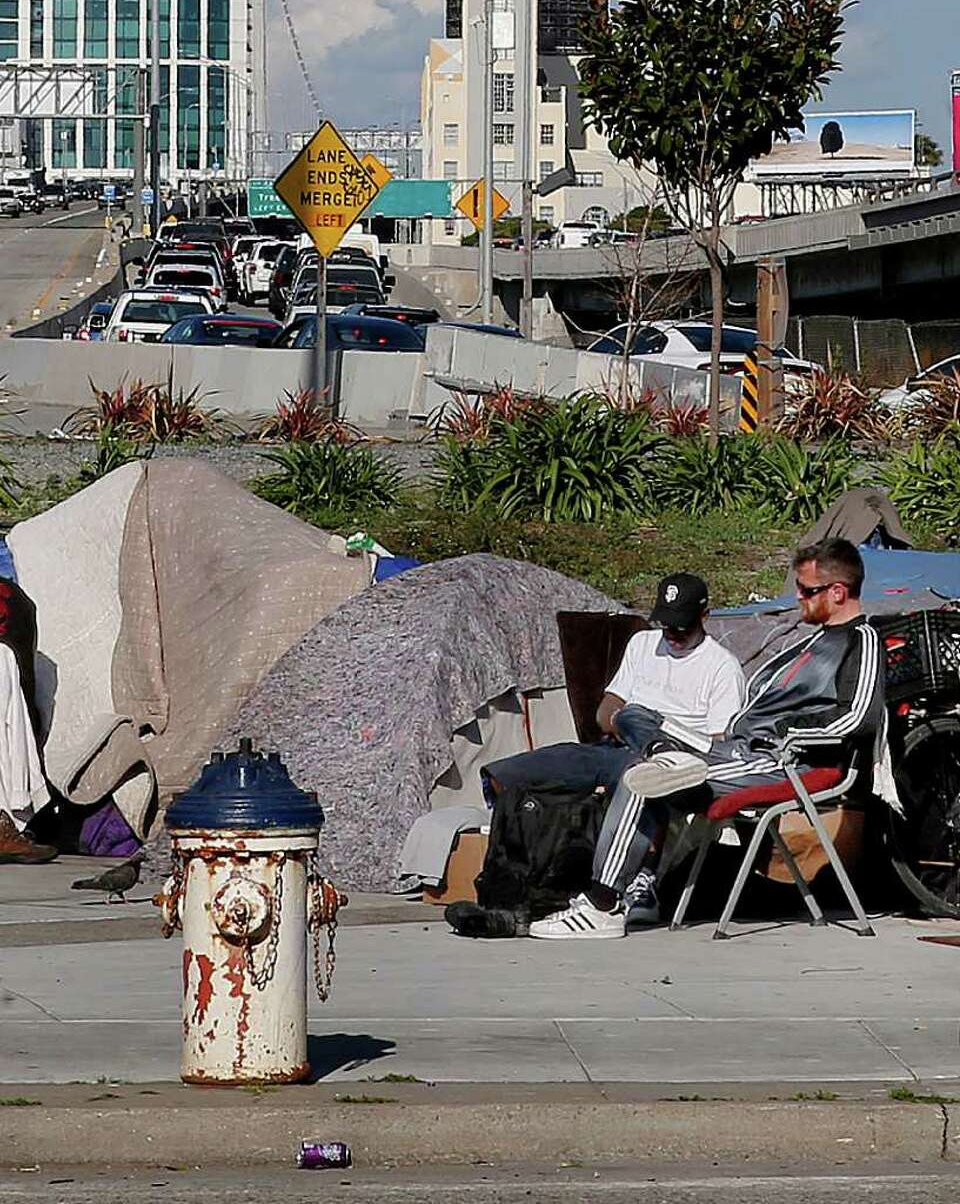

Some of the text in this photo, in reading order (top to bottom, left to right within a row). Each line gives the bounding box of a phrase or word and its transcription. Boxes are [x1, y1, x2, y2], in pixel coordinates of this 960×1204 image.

[307, 150, 346, 164] LANE
[308, 171, 347, 185] ENDS
[300, 192, 351, 207] MERGE
[316, 214, 343, 227] LEFT
